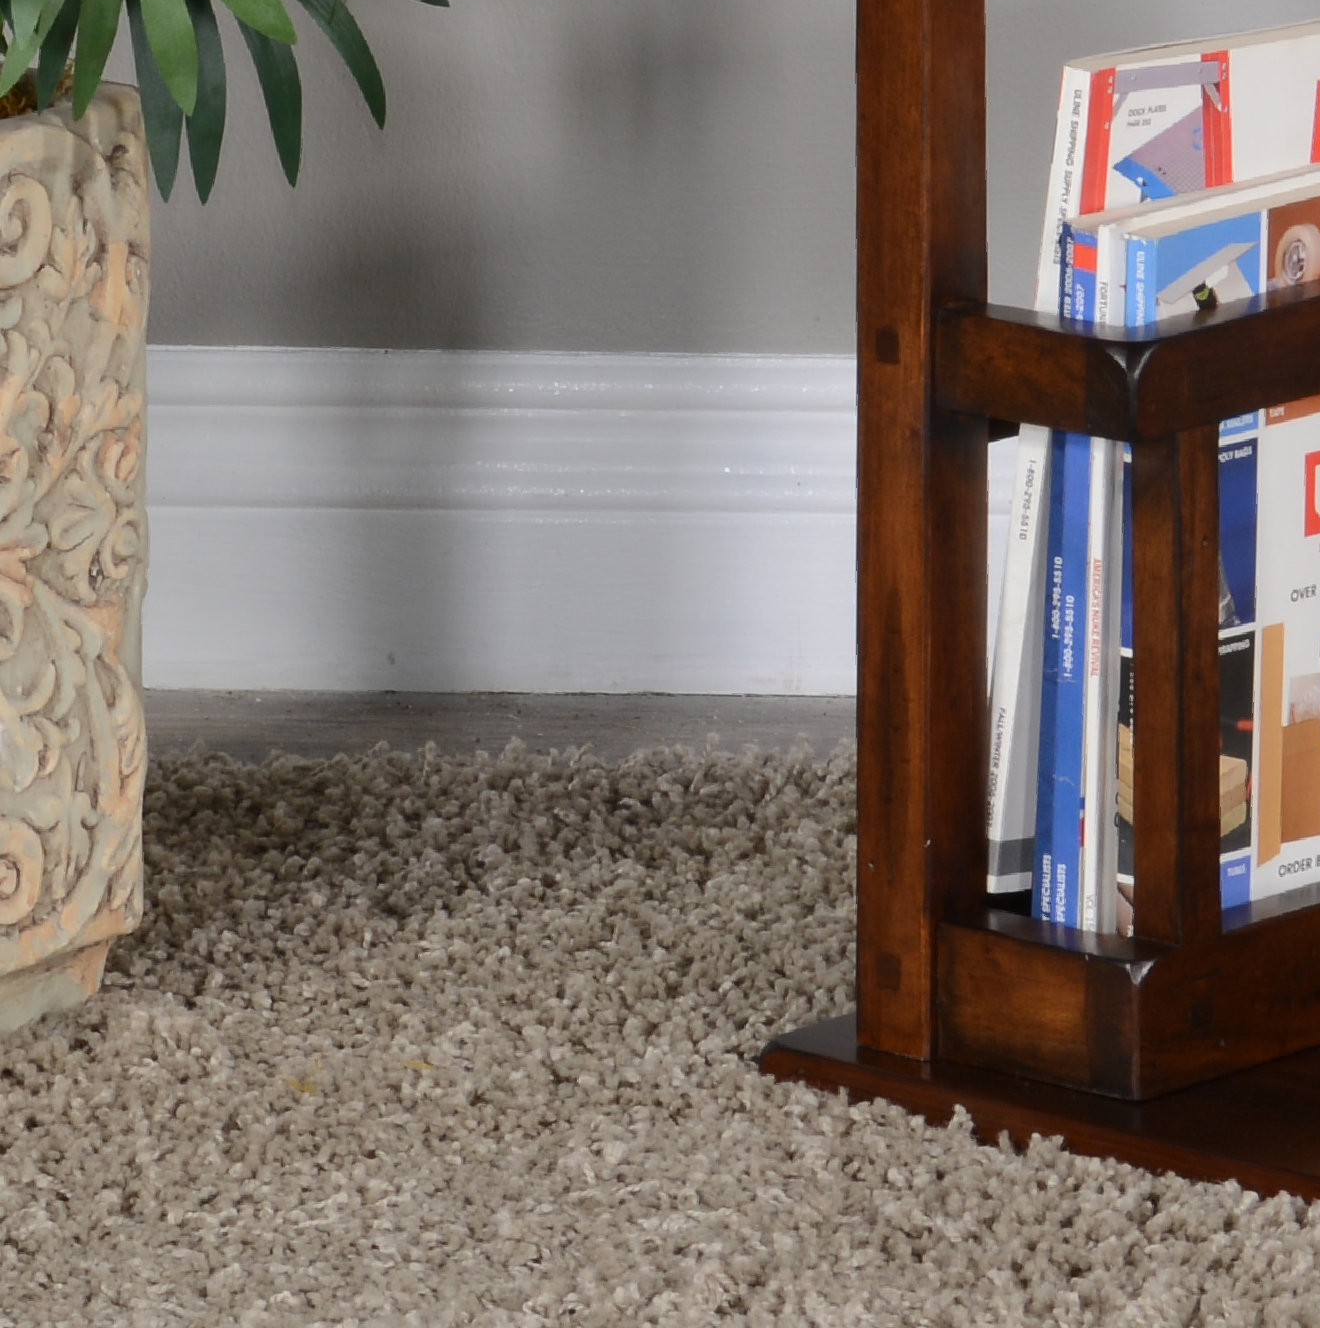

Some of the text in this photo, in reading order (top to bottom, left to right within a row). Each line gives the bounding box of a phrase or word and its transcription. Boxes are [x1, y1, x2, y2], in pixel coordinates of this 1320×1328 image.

[1072, 89, 1082, 115] ULINE
[1066, 120, 1079, 166] SHIPPING
[1060, 170, 1073, 204] SUPPLY
[1135, 250, 1145, 325] ULINE SHIPPIN
[1019, 460, 1036, 540] 1-800-295-5510
[1051, 556, 1063, 639] 1-800-295-5510
[1290, 583, 1317, 602] OVER
[1063, 595, 1075, 677] 1-800-295-5510
[1041, 854, 1051, 913] SPECIALISTS
[1056, 863, 1066, 922] SPECIALISTS
[1278, 857, 1313, 877] ORDER
